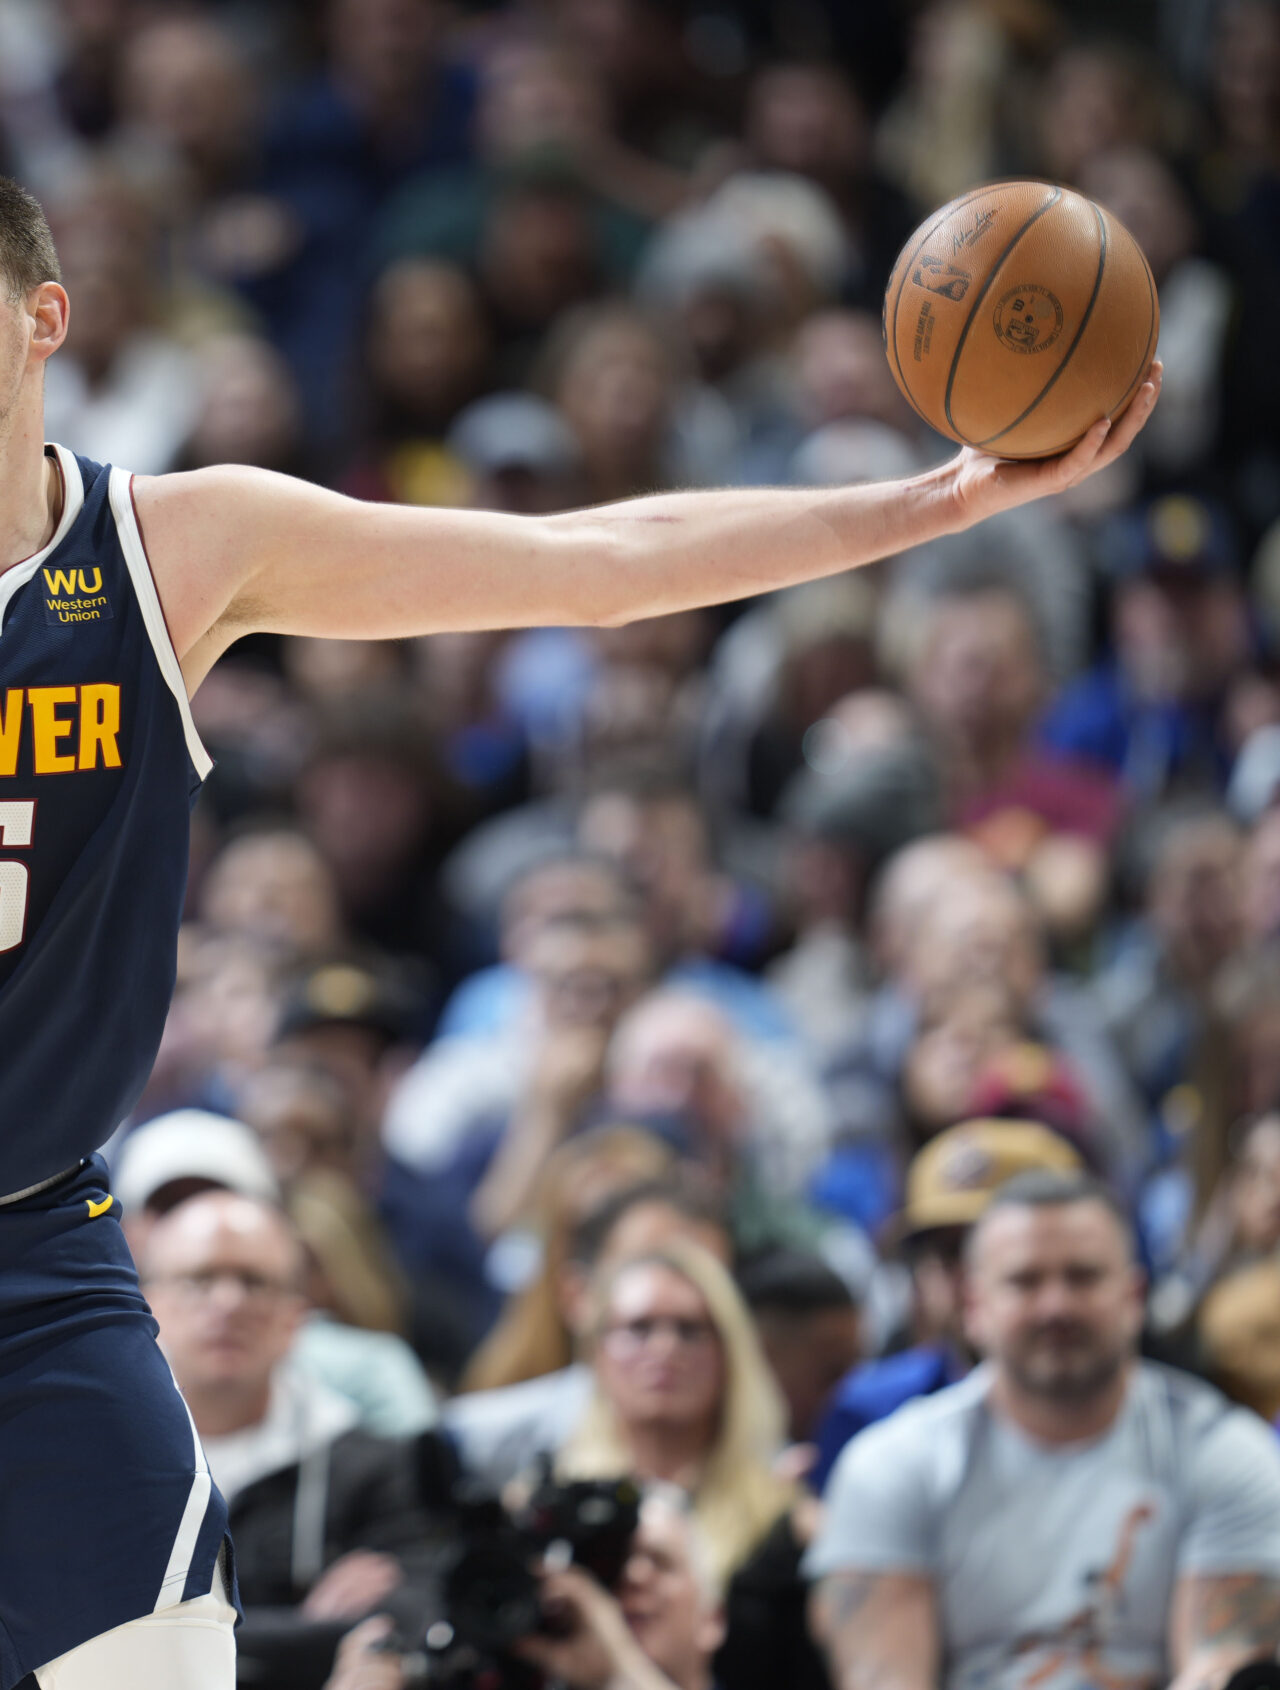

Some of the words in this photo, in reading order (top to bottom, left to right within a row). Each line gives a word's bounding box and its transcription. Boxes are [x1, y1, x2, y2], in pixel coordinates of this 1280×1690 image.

[43, 566, 104, 597] WU
[46, 594, 108, 612] Western
[58, 608, 101, 623] Union
